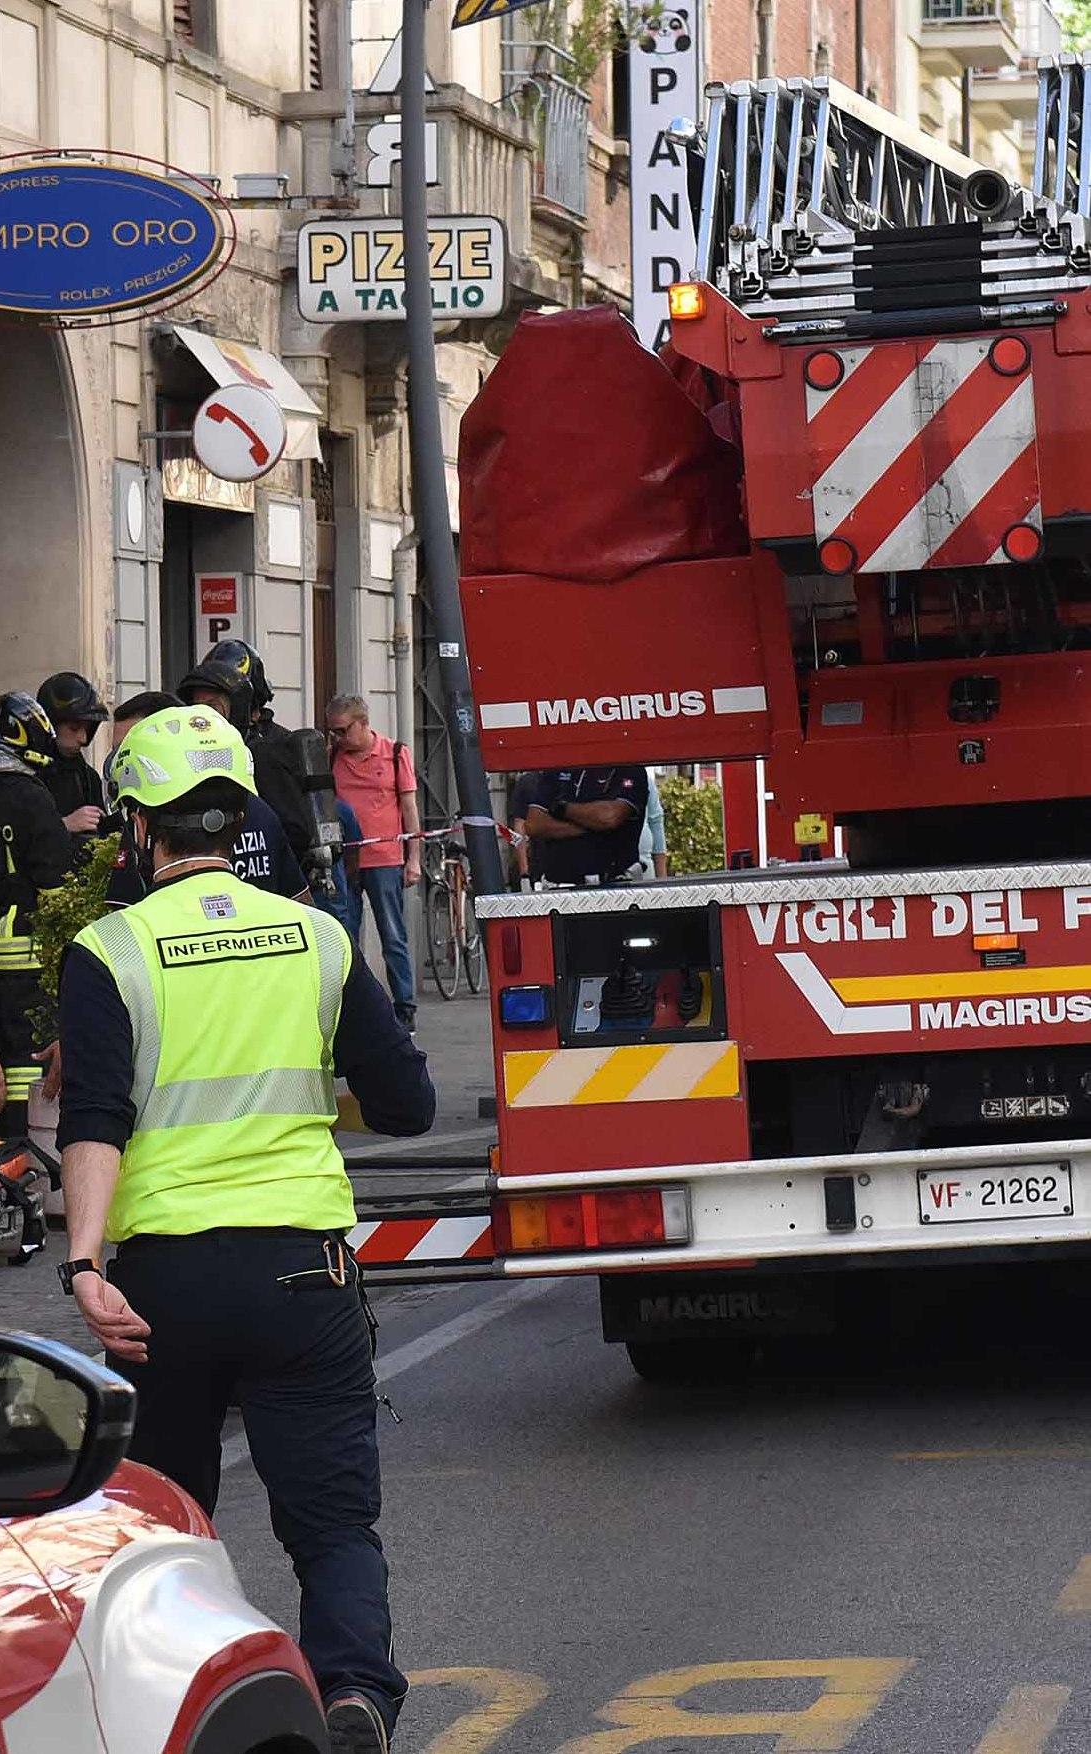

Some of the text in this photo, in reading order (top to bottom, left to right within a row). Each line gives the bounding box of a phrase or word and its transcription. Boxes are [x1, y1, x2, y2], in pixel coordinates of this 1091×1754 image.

[112, 219, 197, 246] ORO
[308, 228, 493, 284] PIZZE
[60, 287, 111, 302] ROLEX
[124, 253, 191, 292] PREZIOSI
[317, 286, 484, 313] A TALIO
[209, 618, 231, 643] P
[536, 690, 707, 727] MAGIRUS
[233, 830, 267, 855] LIZIA
[234, 855, 271, 881] CALE
[745, 896, 907, 946] VIGILI
[931, 889, 1039, 938] DEL
[167, 932, 298, 958] INFERMIERE
[919, 995, 1091, 1031] MAGIRUS
[930, 1176, 1059, 1209] VF 21262
